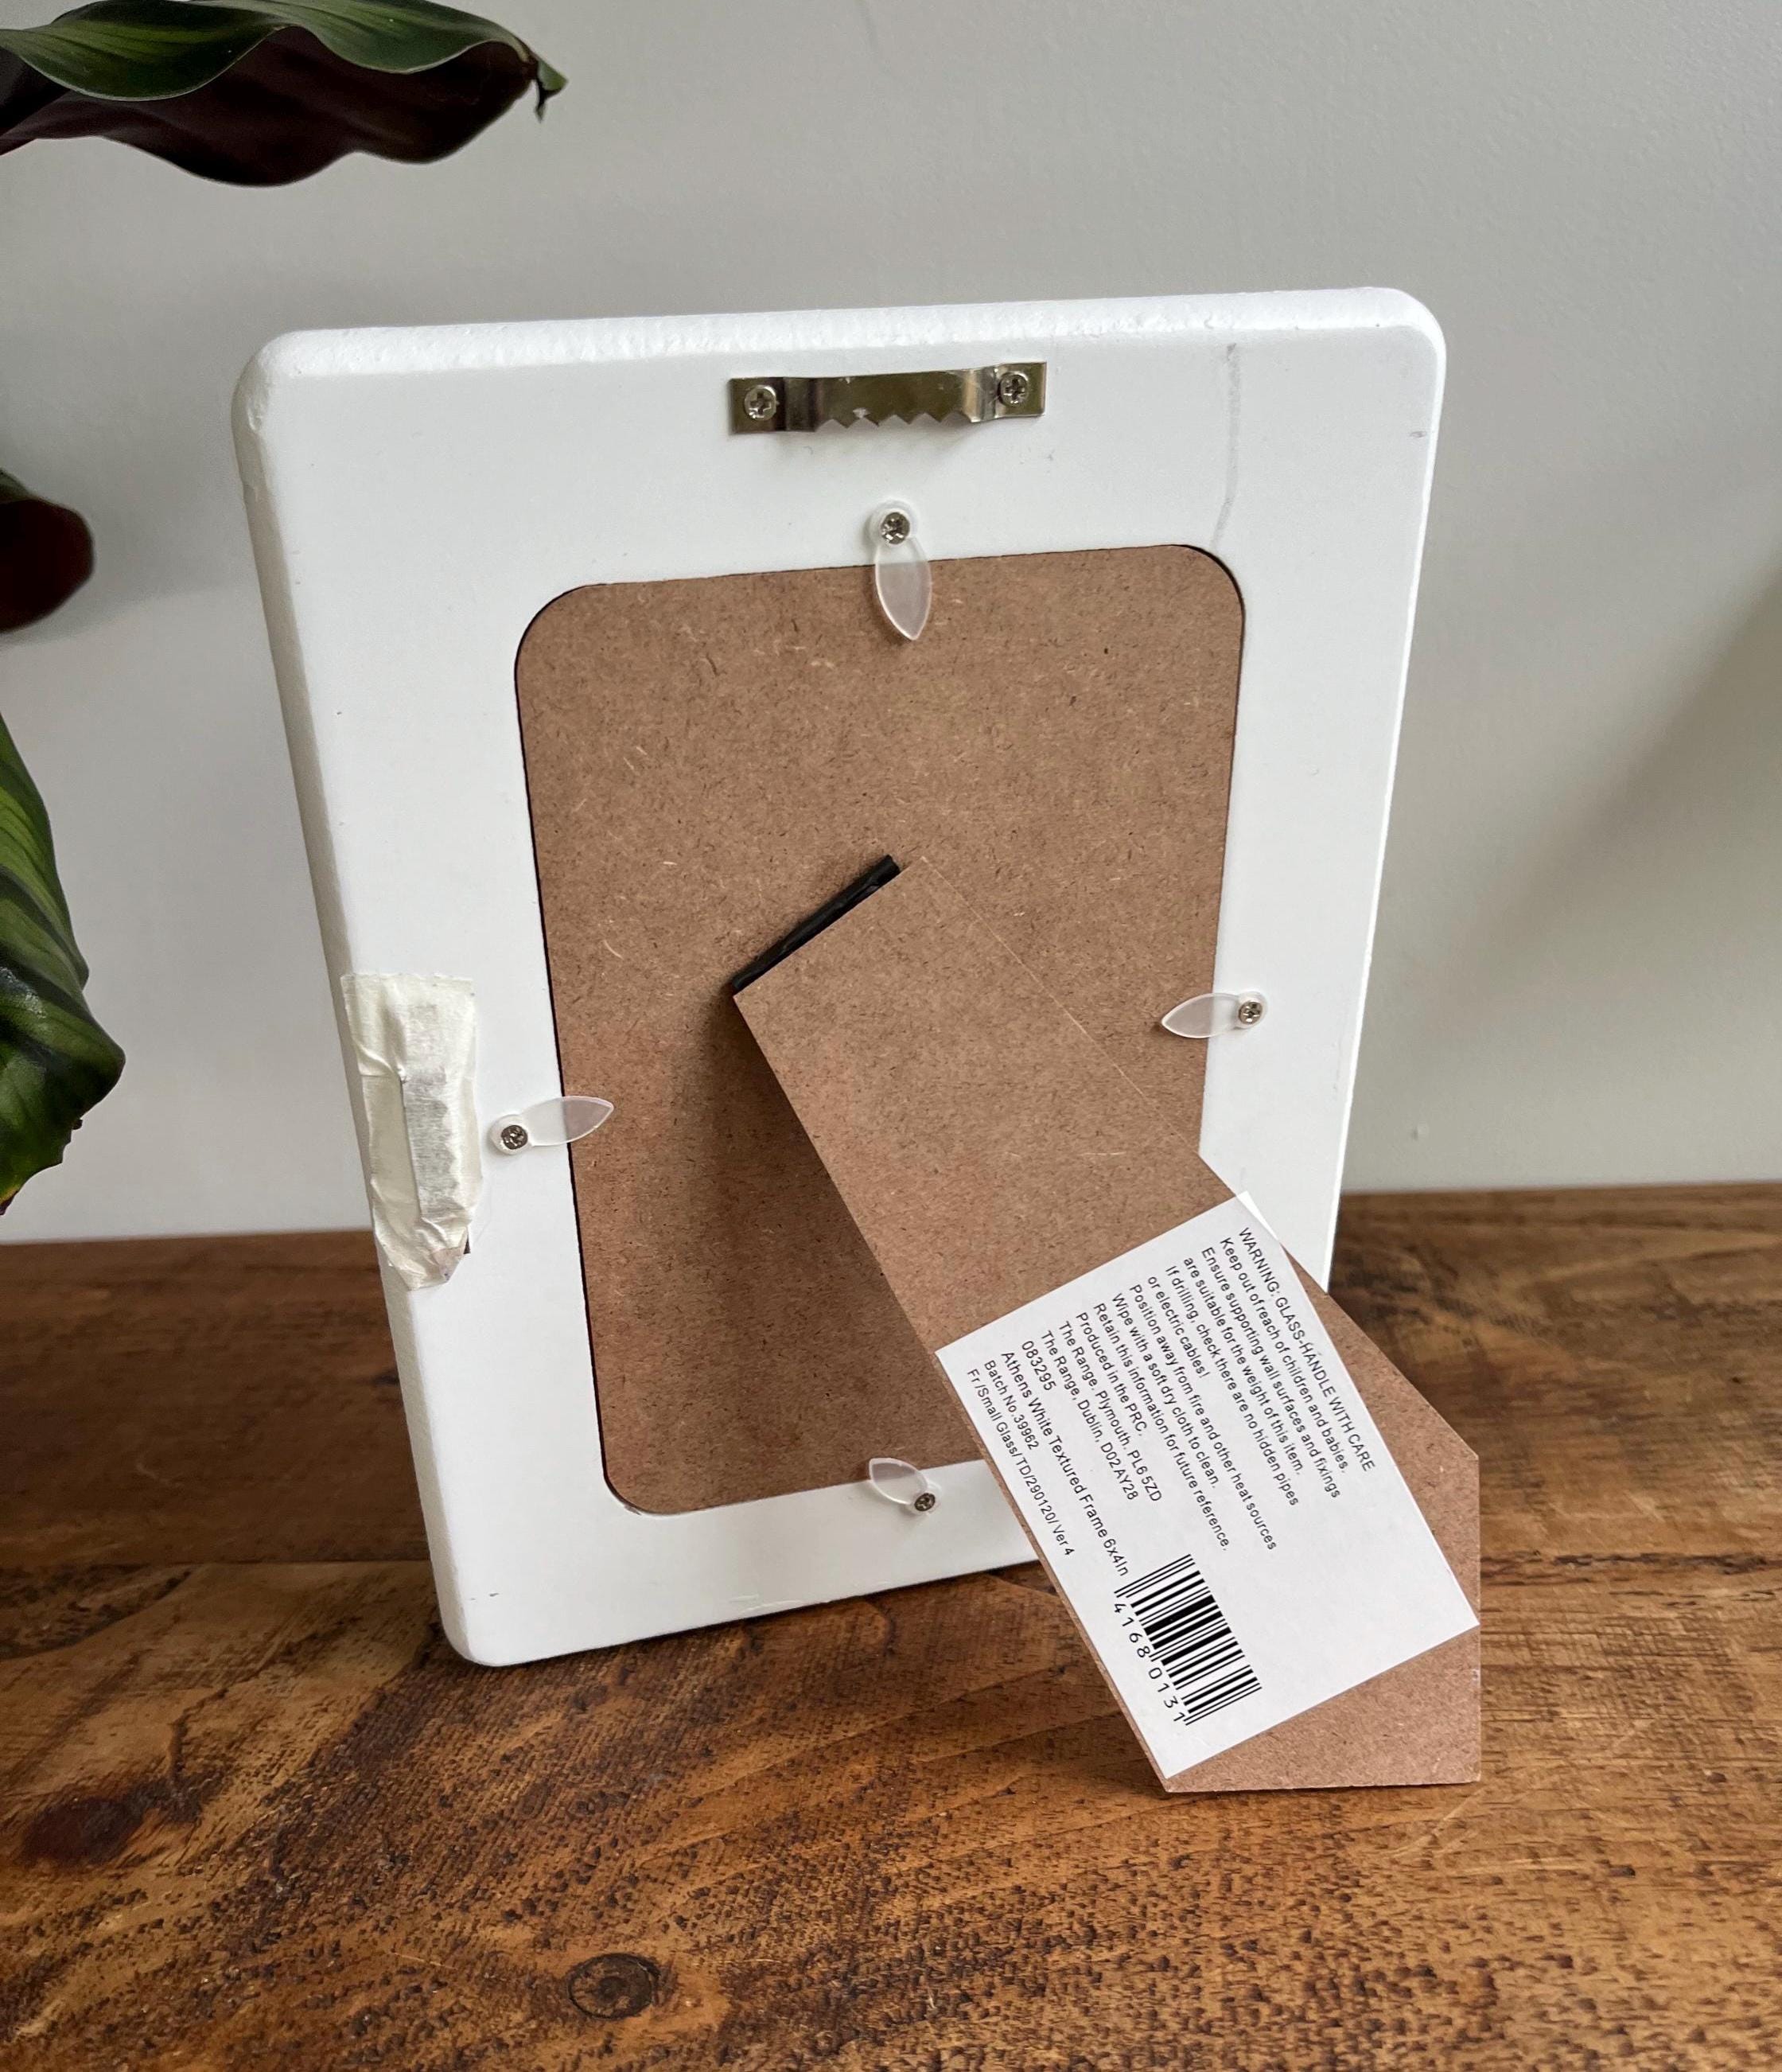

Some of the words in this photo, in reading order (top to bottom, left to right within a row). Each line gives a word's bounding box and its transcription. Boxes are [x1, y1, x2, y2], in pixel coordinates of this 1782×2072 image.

[1165, 1265, 1181, 1276] If
[1183, 1257, 1200, 1279] are
[1219, 1237, 1243, 1271] Keep
[1237, 1272, 1256, 1293] out
[1249, 1293, 1266, 1306] of
[1111, 1292, 1134, 1326] Wipe
[1171, 1277, 1199, 1323] drilling,
[1194, 1279, 1226, 1327] suitable
[1128, 1326, 1149, 1353] with
[1147, 1276, 1161, 1289] or
[1154, 1291, 1185, 1336] electric
[1179, 1336, 1211, 1378] cables!
[1220, 1326, 1236, 1344] for
[1255, 1306, 1281, 1340] reach
[1142, 1353, 1153, 1362] a
[1196, 1323, 1221, 1359] check
[1230, 1343, 1247, 1365] the
[1238, 1226, 1280, 1297] WARNING:
[1328, 1396, 1356, 1434] WITH
[1347, 1433, 1375, 1472] CARE
[1274, 1340, 1291, 1353] of
[983, 1359, 1008, 1396] Batch
[1021, 1340, 1057, 1391] 083295
[1075, 1311, 1115, 1371] Produced
[1106, 1369, 1119, 1384] in
[1113, 1382, 1130, 1404] the
[1123, 1402, 1148, 1436] PRC.
[1147, 1362, 1168, 1386] soft
[1200, 1246, 1231, 1291] Ensure
[1224, 1292, 1265, 1355] supporting
[1259, 1353, 1281, 1381] wall
[1272, 1381, 1305, 1433] surfaces
[1300, 1433, 1322, 1458] and
[1313, 1457, 1340, 1498] fixings
[1214, 1357, 1237, 1391] there
[1282, 1354, 1313, 1404] children
[1041, 1329, 1058, 1356] The
[1052, 1355, 1080, 1400] Range,
[1076, 1398, 1103, 1443] Dublin,
[1160, 1385, 1177, 1405] dry
[1231, 1391, 1249, 1412] are
[1241, 1365, 1270, 1407] weight
[1058, 1320, 1076, 1347] The
[1126, 1449, 1148, 1475] PL6
[1140, 1475, 1162, 1501] 5ZD
[1092, 1302, 1120, 1345] Retain
[1115, 1343, 1134, 1368] this
[1126, 1365, 1169, 1434] information
[1163, 1433, 1180, 1451] for
[1173, 1451, 1198, 1489] future
[1193, 1489, 1229, 1551] reference.
[1128, 1283, 1161, 1335] Position
[1155, 1335, 1179, 1366] away
[1172, 1365, 1193, 1395] from
[1188, 1394, 1205, 1416] fire
[1200, 1416, 1221, 1441] and
[1212, 1441, 1237, 1472] other
[1230, 1472, 1253, 1502] heat
[1245, 1501, 1277, 1550] sources
[1171, 1406, 1194, 1437] cloth
[1243, 1412, 1258, 1429] no
[1263, 1407, 1279, 1420] of
[1307, 1404, 1329, 1428] and
[1000, 1352, 1033, 1398] Athens
[1027, 1396, 1053, 1437] White
[1048, 1434, 1087, 1494] Textured
[1078, 1494, 1108, 1538] Frame
[1187, 1435, 1200, 1450] to
[1270, 1419, 1289, 1443] this
[1251, 1427, 1281, 1472] hidden
[1282, 1442, 1303, 1475] item.
[1321, 1427, 1348, 1473] babies.
[1195, 1451, 1219, 1489] clean.
[1272, 1472, 1299, 1505] pipes
[1052, 1524, 1069, 1546] Ver
